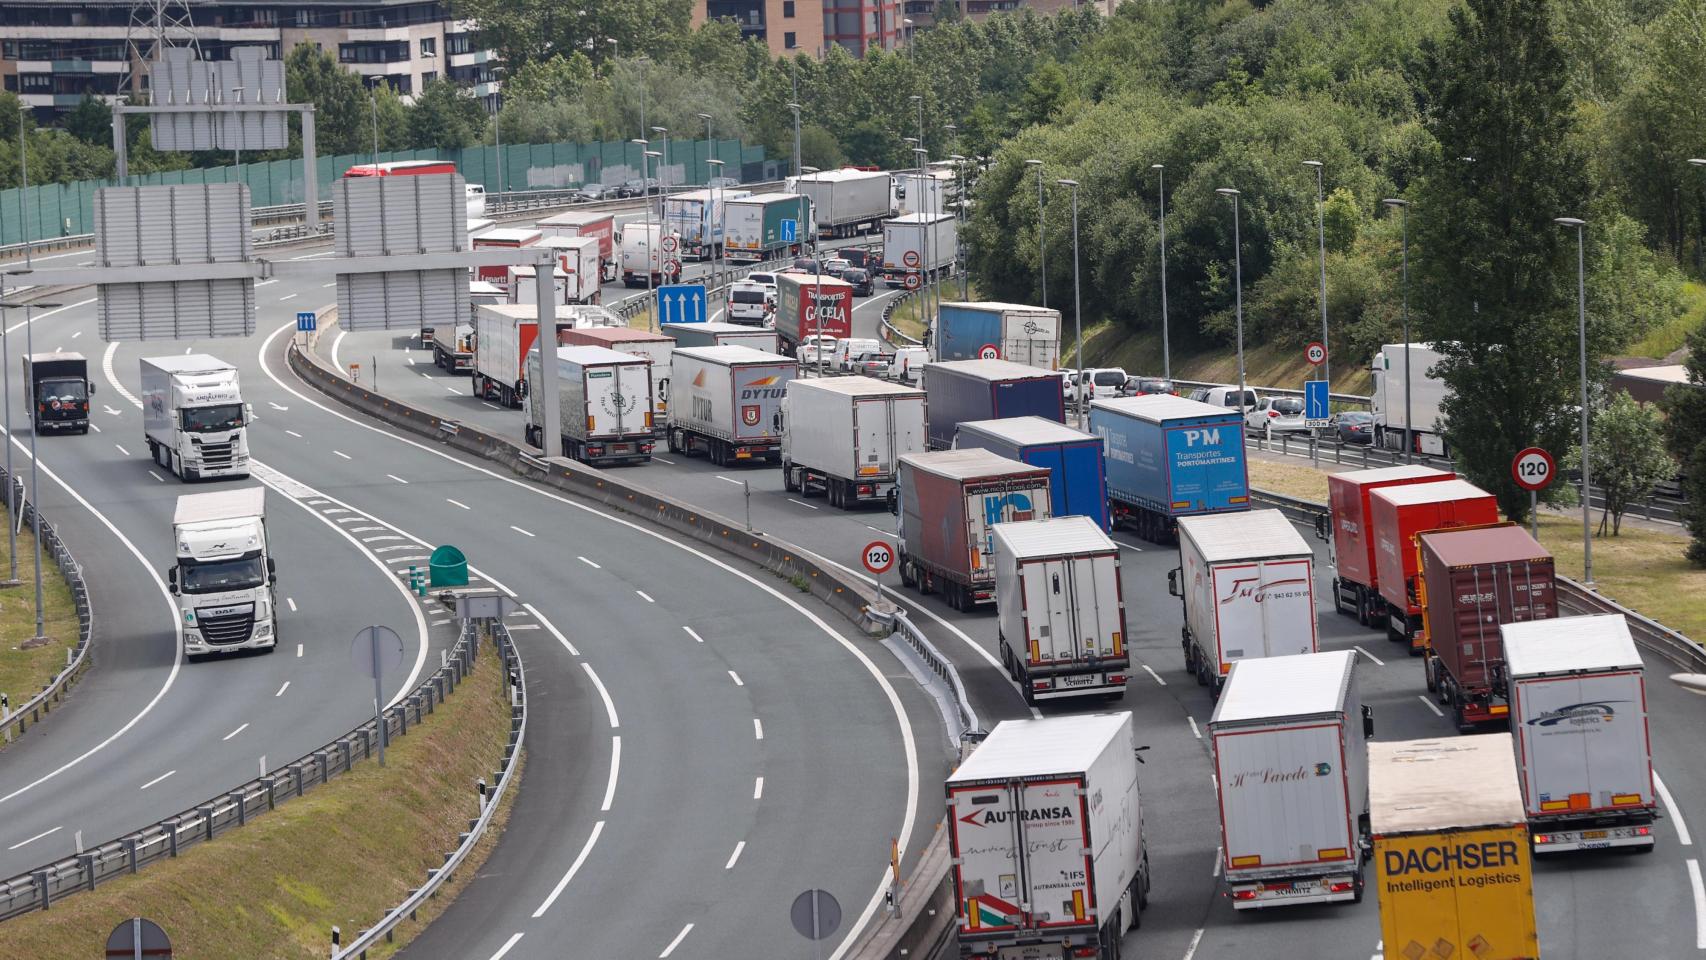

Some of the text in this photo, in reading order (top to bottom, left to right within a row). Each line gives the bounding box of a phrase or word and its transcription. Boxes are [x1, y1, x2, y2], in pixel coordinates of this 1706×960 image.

[805, 305, 846, 323] GACELA
[983, 351, 995, 360] 60
[1310, 350, 1322, 358] 60
[692, 395, 713, 423] DYTUR
[1183, 428, 1220, 447] PM
[1176, 450, 1221, 461] Transportes
[1519, 461, 1547, 476] 120
[868, 551, 889, 563] 120
[984, 806, 1073, 824] AUTRANSA
[1384, 841, 1520, 876] DACHSER
[1069, 870, 1085, 879] IFS
[1387, 873, 1521, 893] Intelligent Logistics
